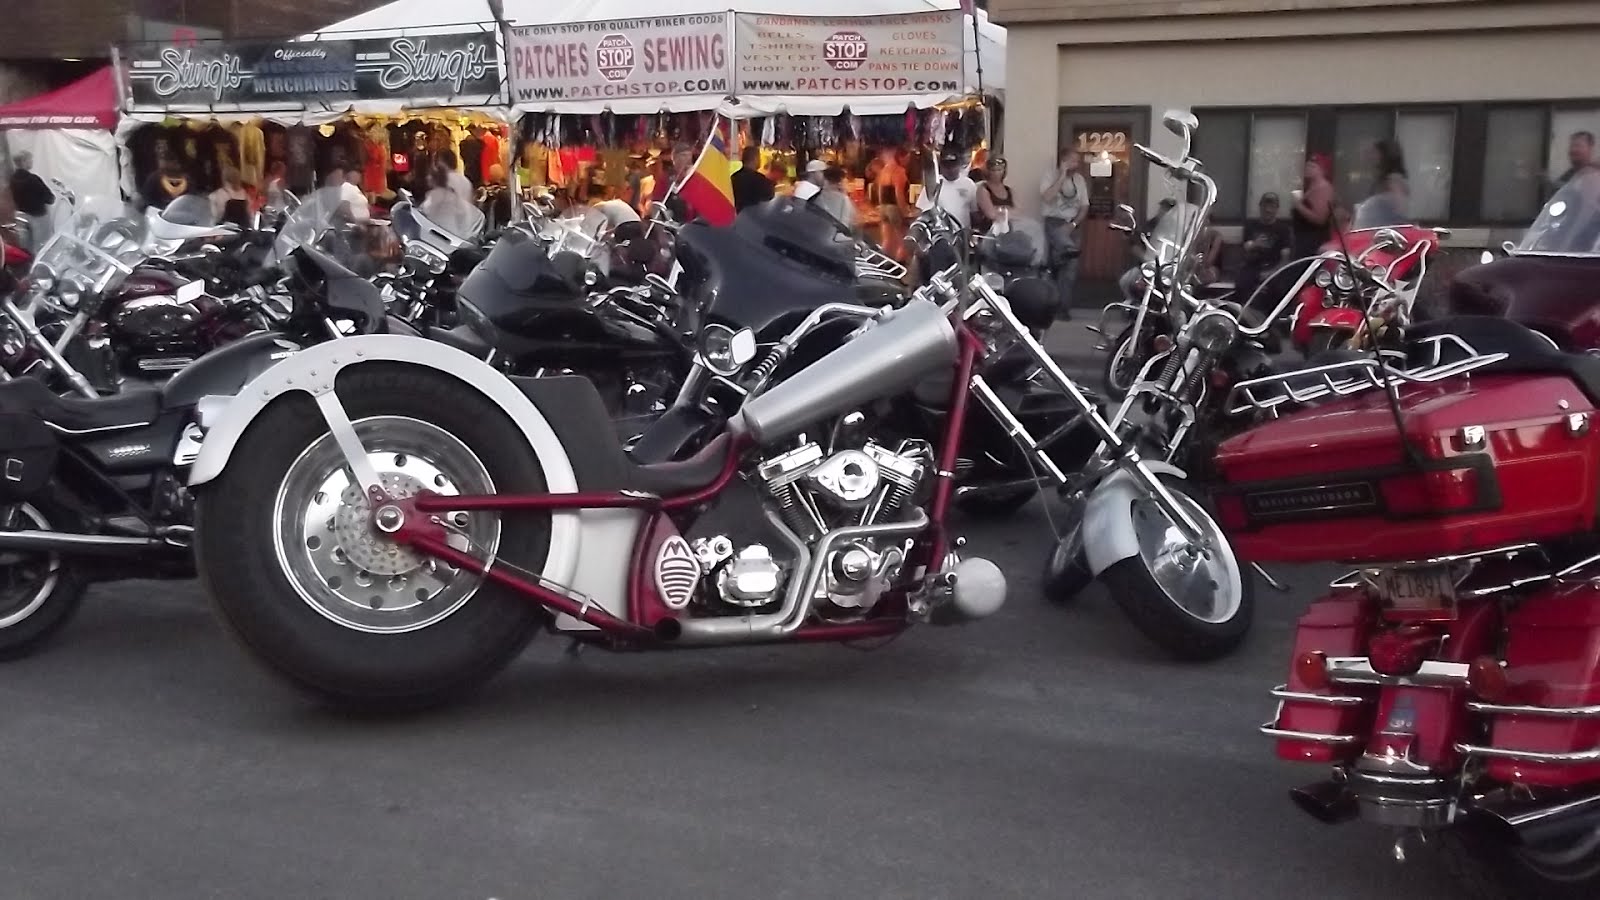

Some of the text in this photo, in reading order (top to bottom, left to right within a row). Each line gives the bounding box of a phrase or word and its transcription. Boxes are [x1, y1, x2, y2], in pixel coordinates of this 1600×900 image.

[512, 15, 724, 37] THE ONLY STOP FOR QUALITY BIKER GOODS
[913, 14, 952, 24] MASKS
[757, 31, 805, 39] BELLS
[892, 31, 937, 41] GLOVES
[603, 38, 628, 48] PATCH
[826, 42, 866, 59] STOP
[274, 48, 327, 61] Officially
[599, 49, 632, 67] STOP
[643, 33, 725, 73] SEWING
[743, 54, 781, 62] VEST
[879, 47, 947, 56] KEYCHAINS
[380, 39, 488, 92] Sturgis
[514, 42, 590, 80] PATCHES
[868, 61, 959, 71] PANS TIE DOWN
[153, 48, 248, 100] Sturgis
[742, 65, 785, 73] CHOP
[253, 74, 358, 94] MERCHANDISE
[518, 78, 727, 100] WWW.PATCHSTOP.COM
[742, 78, 958, 91] WWW.PATCHSTOP.COM
[1078, 131, 1126, 153] 1222
